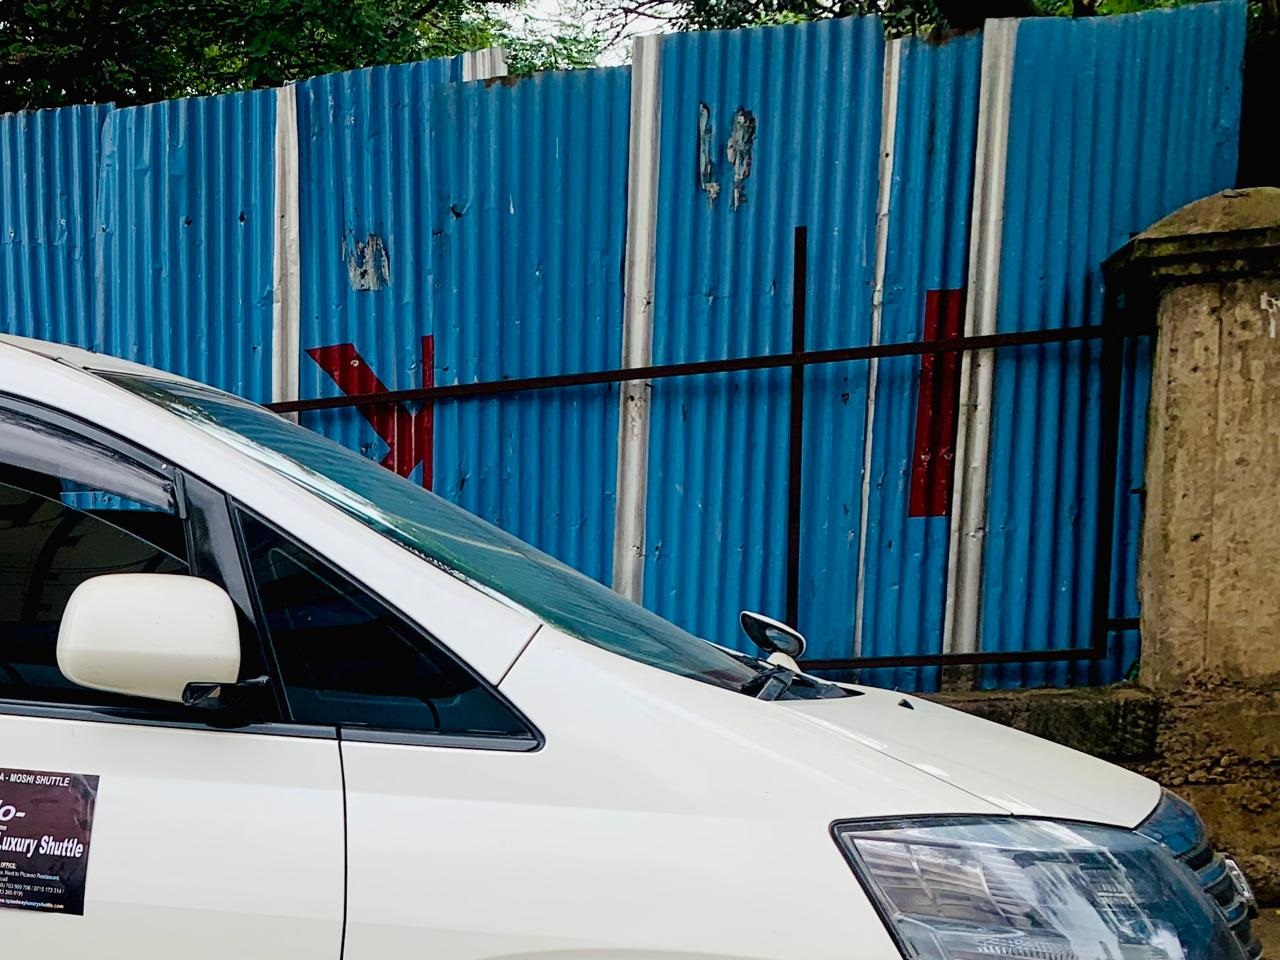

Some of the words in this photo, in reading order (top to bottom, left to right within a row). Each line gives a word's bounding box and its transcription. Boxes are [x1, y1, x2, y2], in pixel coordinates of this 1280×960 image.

[10, 773, 34, 784] MOSHI
[35, 775, 70, 786] SHUTTLE
[39, 835, 83, 858] Shuttle
